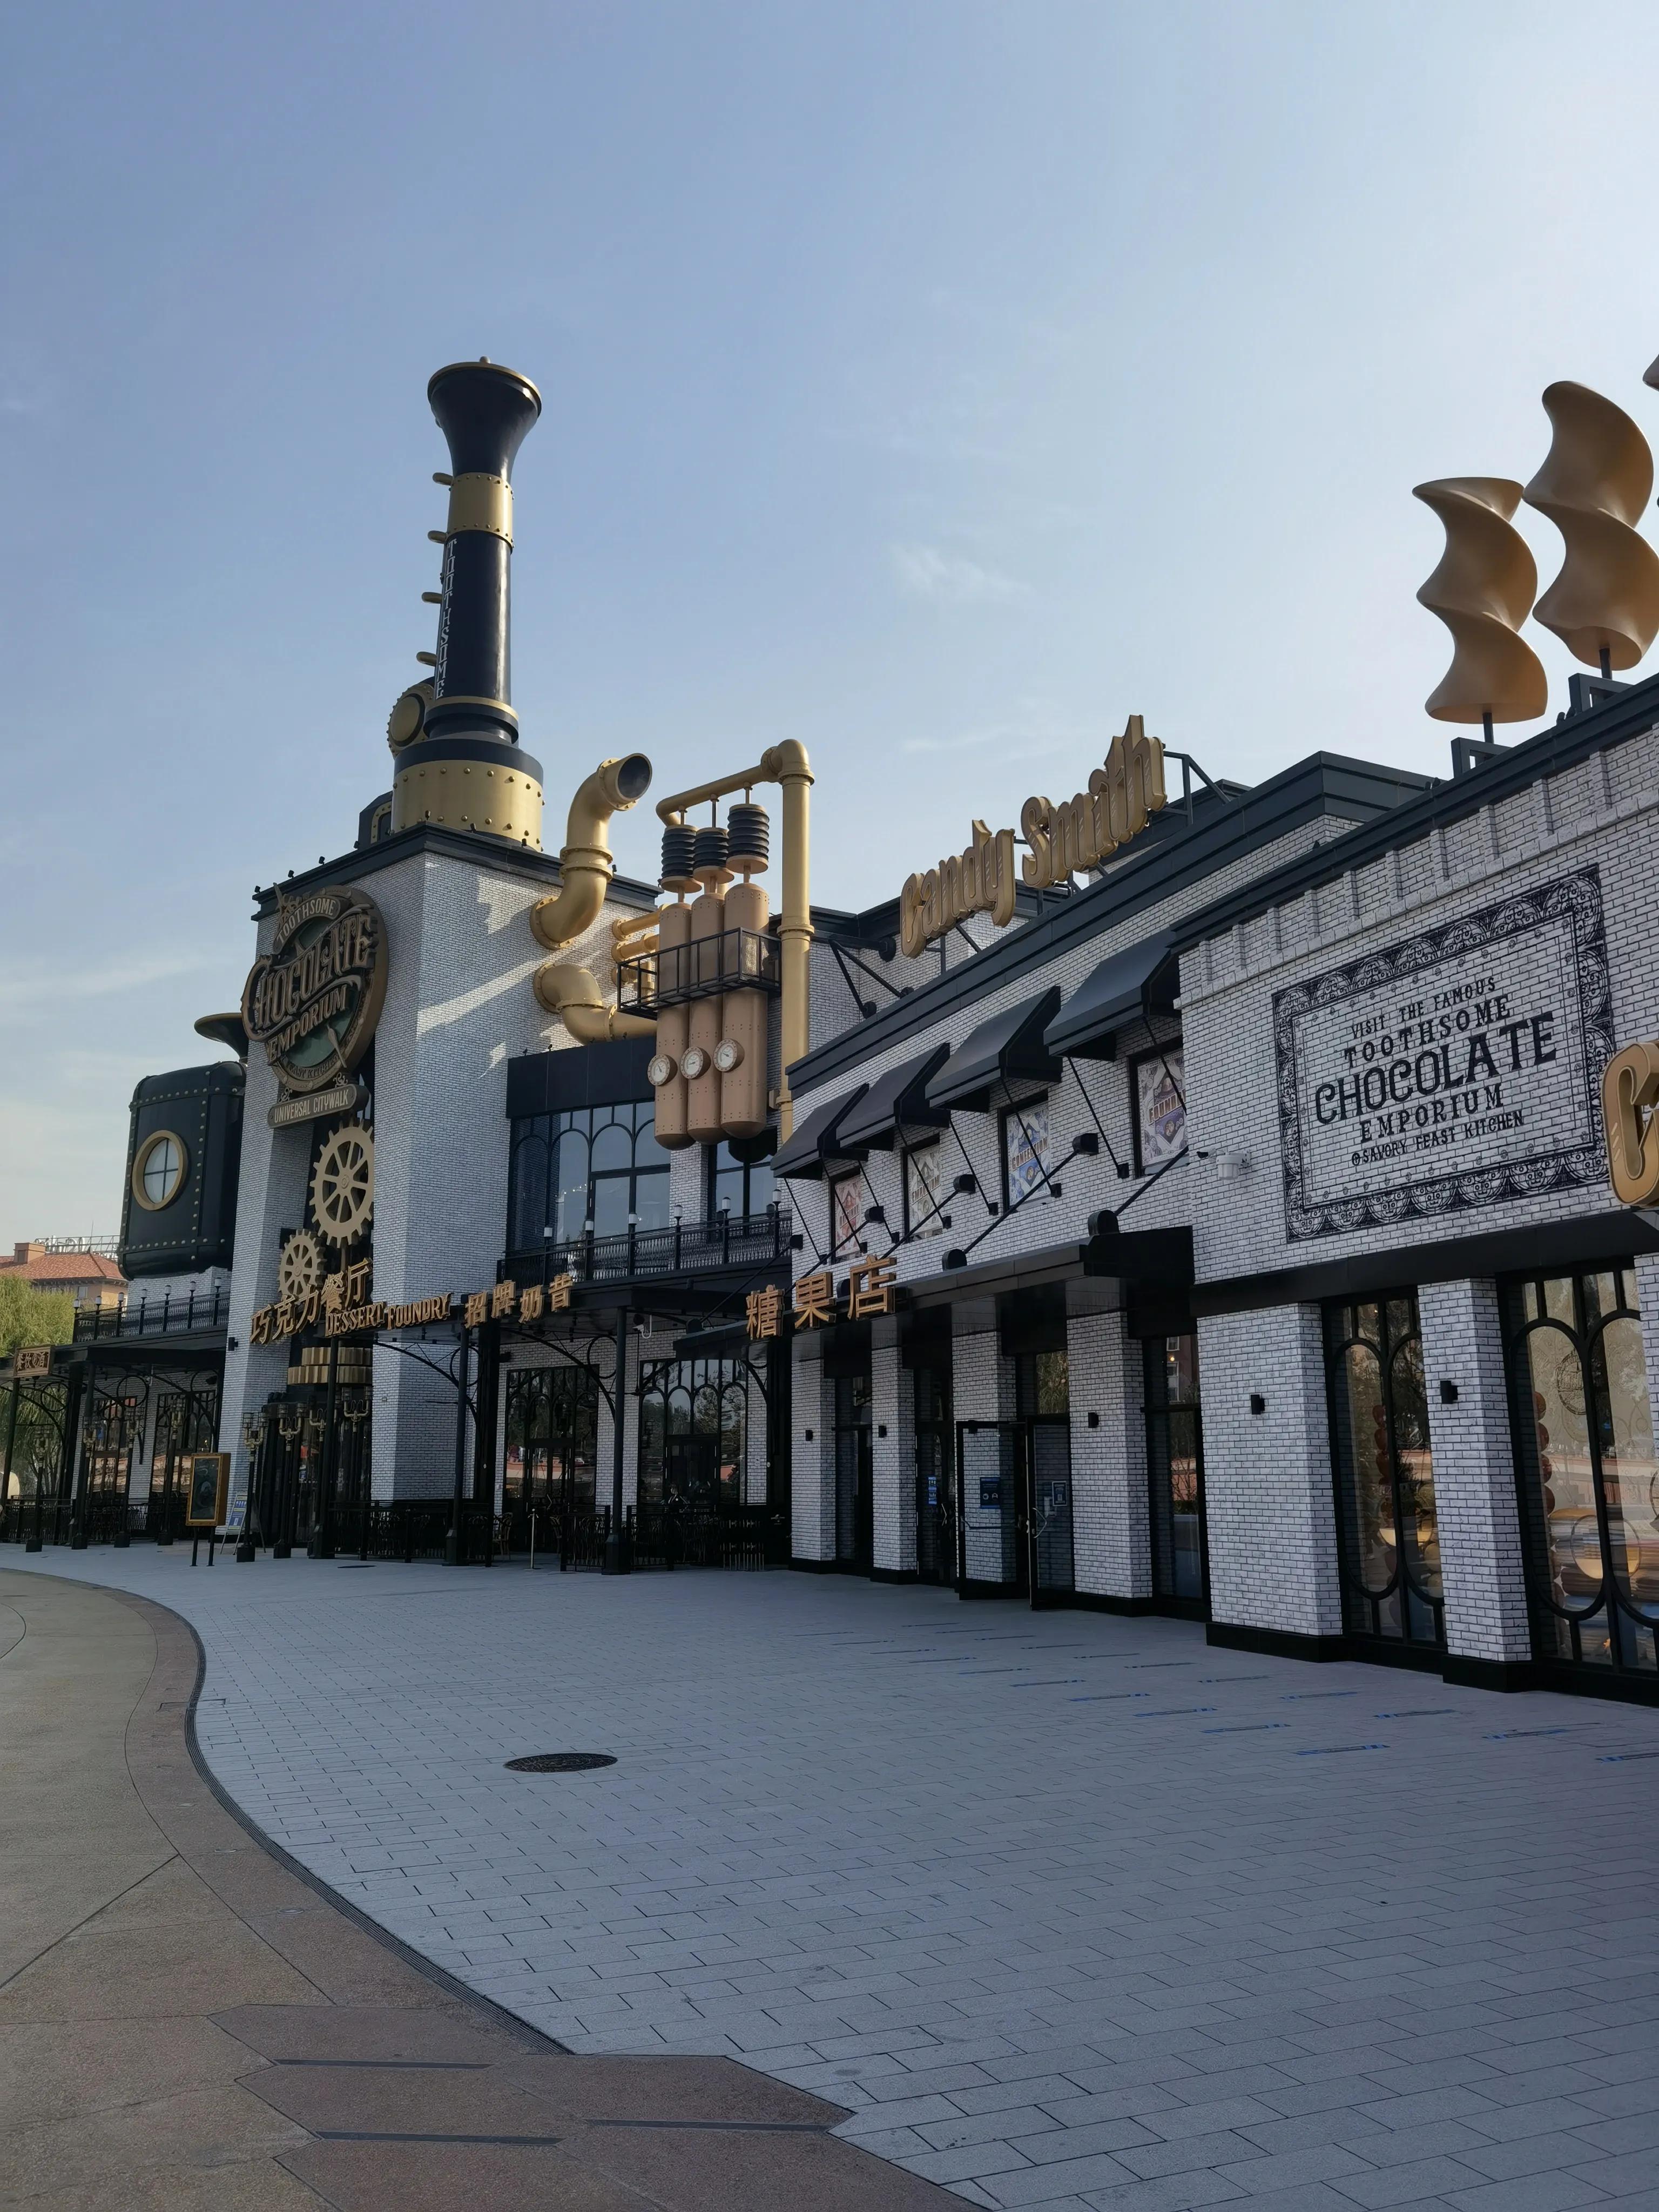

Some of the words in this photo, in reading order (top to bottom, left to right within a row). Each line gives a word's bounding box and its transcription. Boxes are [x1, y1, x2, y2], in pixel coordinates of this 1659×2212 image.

[436, 538, 457, 700] TOOTHSOME
[900, 819, 1015, 958] Candy
[1021, 714, 1167, 889] Smith
[276, 897, 336, 945] TOOTHSOME
[241, 913, 373, 1041] CHOCOLATE
[1351, 1014, 1385, 1040] VISIT
[1399, 1001, 1425, 1024] THE
[1433, 977, 1495, 1010] FAMOUS
[267, 985, 346, 1065] EMPORIUM
[1344, 994, 1510, 1069] TOOTHSOME
[1315, 1011, 1556, 1124] CHOCOLATE
[274, 1103, 311, 1123] UNIVERSAL
[313, 1089, 349, 1112] CITYWALK
[1359, 1082, 1504, 1143] EMPORIUM
[1415, 1128, 1456, 1150] FEAST
[1464, 1110, 1524, 1138] KITCHEN
[249, 1257, 373, 1345] 巧克力餐厅
[325, 1302, 385, 1338] DESSERT
[386, 1292, 451, 1330] FOUNDRY
[464, 1272, 575, 1329] 招牌奶昔
[746, 1255, 897, 1340] 糖果店
